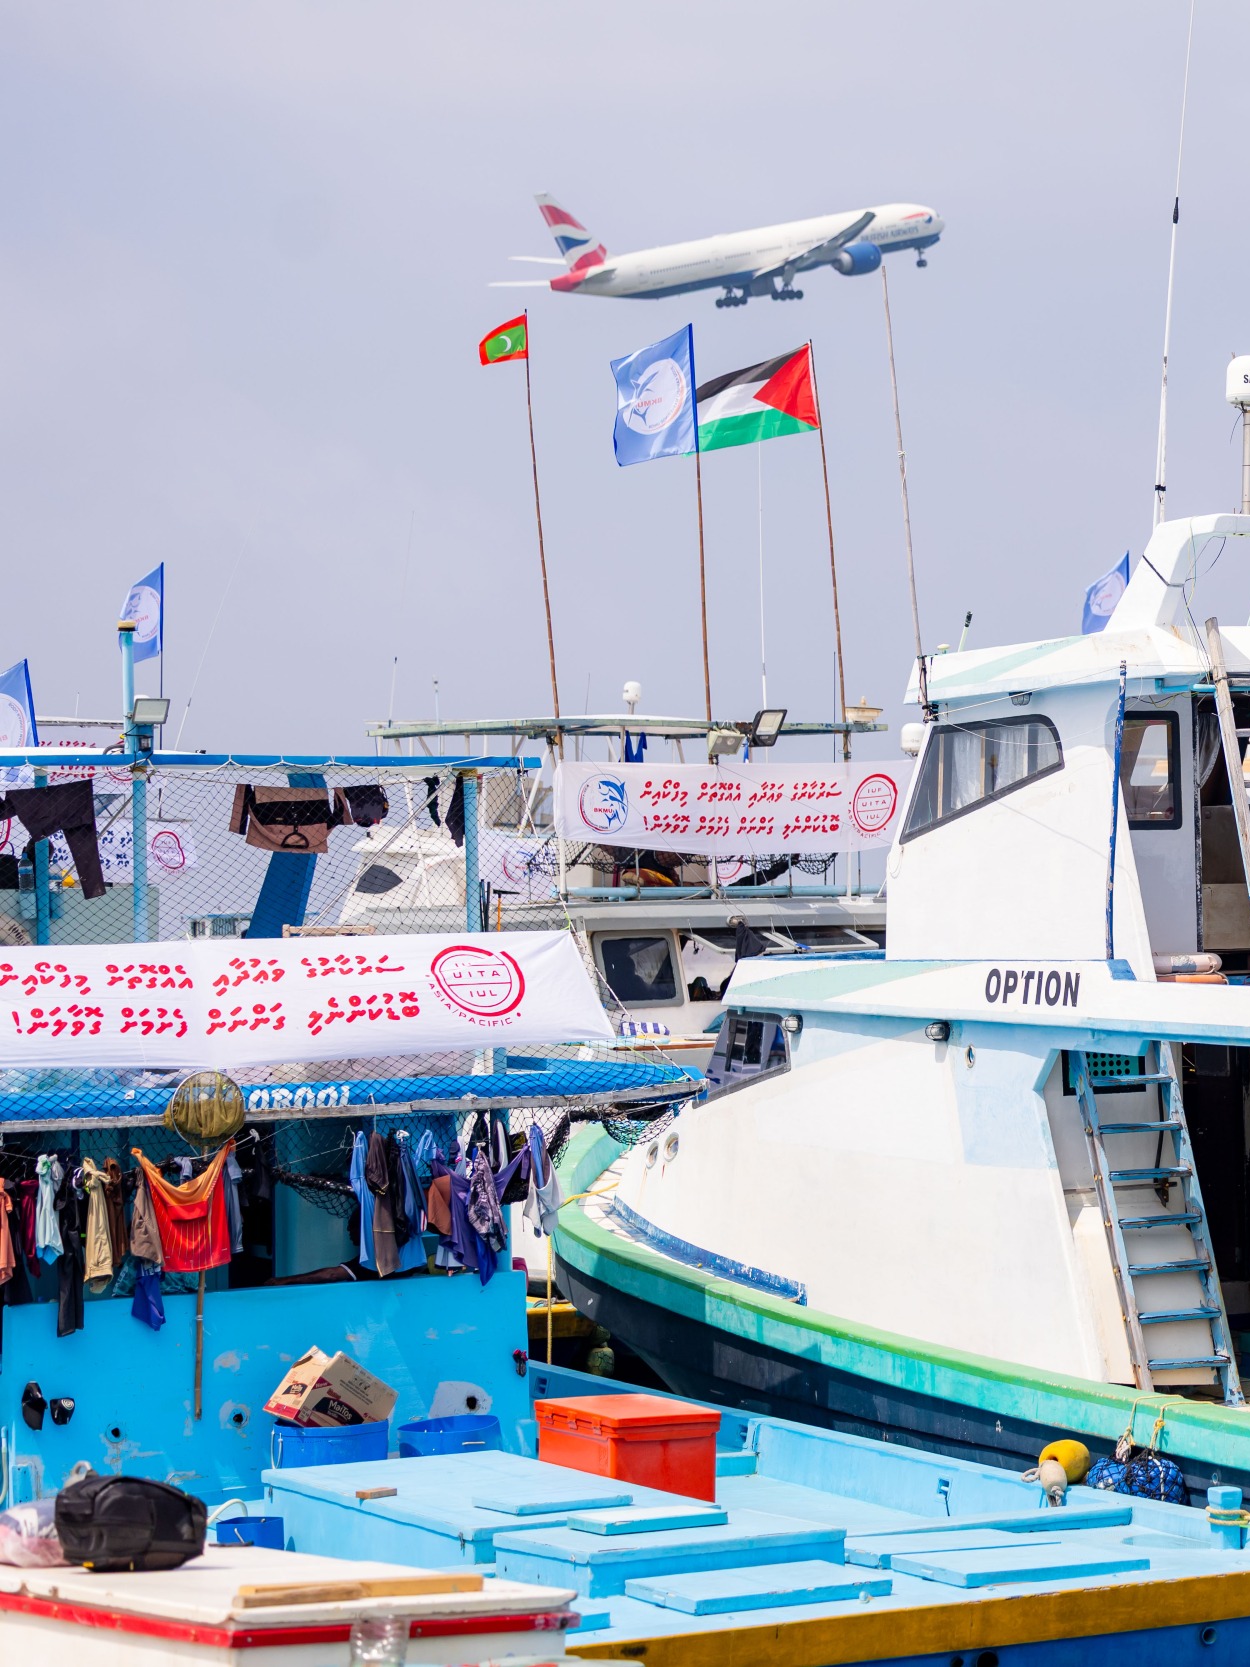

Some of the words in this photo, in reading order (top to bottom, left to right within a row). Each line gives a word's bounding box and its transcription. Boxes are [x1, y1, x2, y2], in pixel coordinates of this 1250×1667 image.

[453, 970, 500, 978] UITA
[985, 968, 1081, 1008] OPTION
[428, 983, 512, 1027] ASIA/PACIFIC
[328, 1400, 353, 1420] MaiTos
